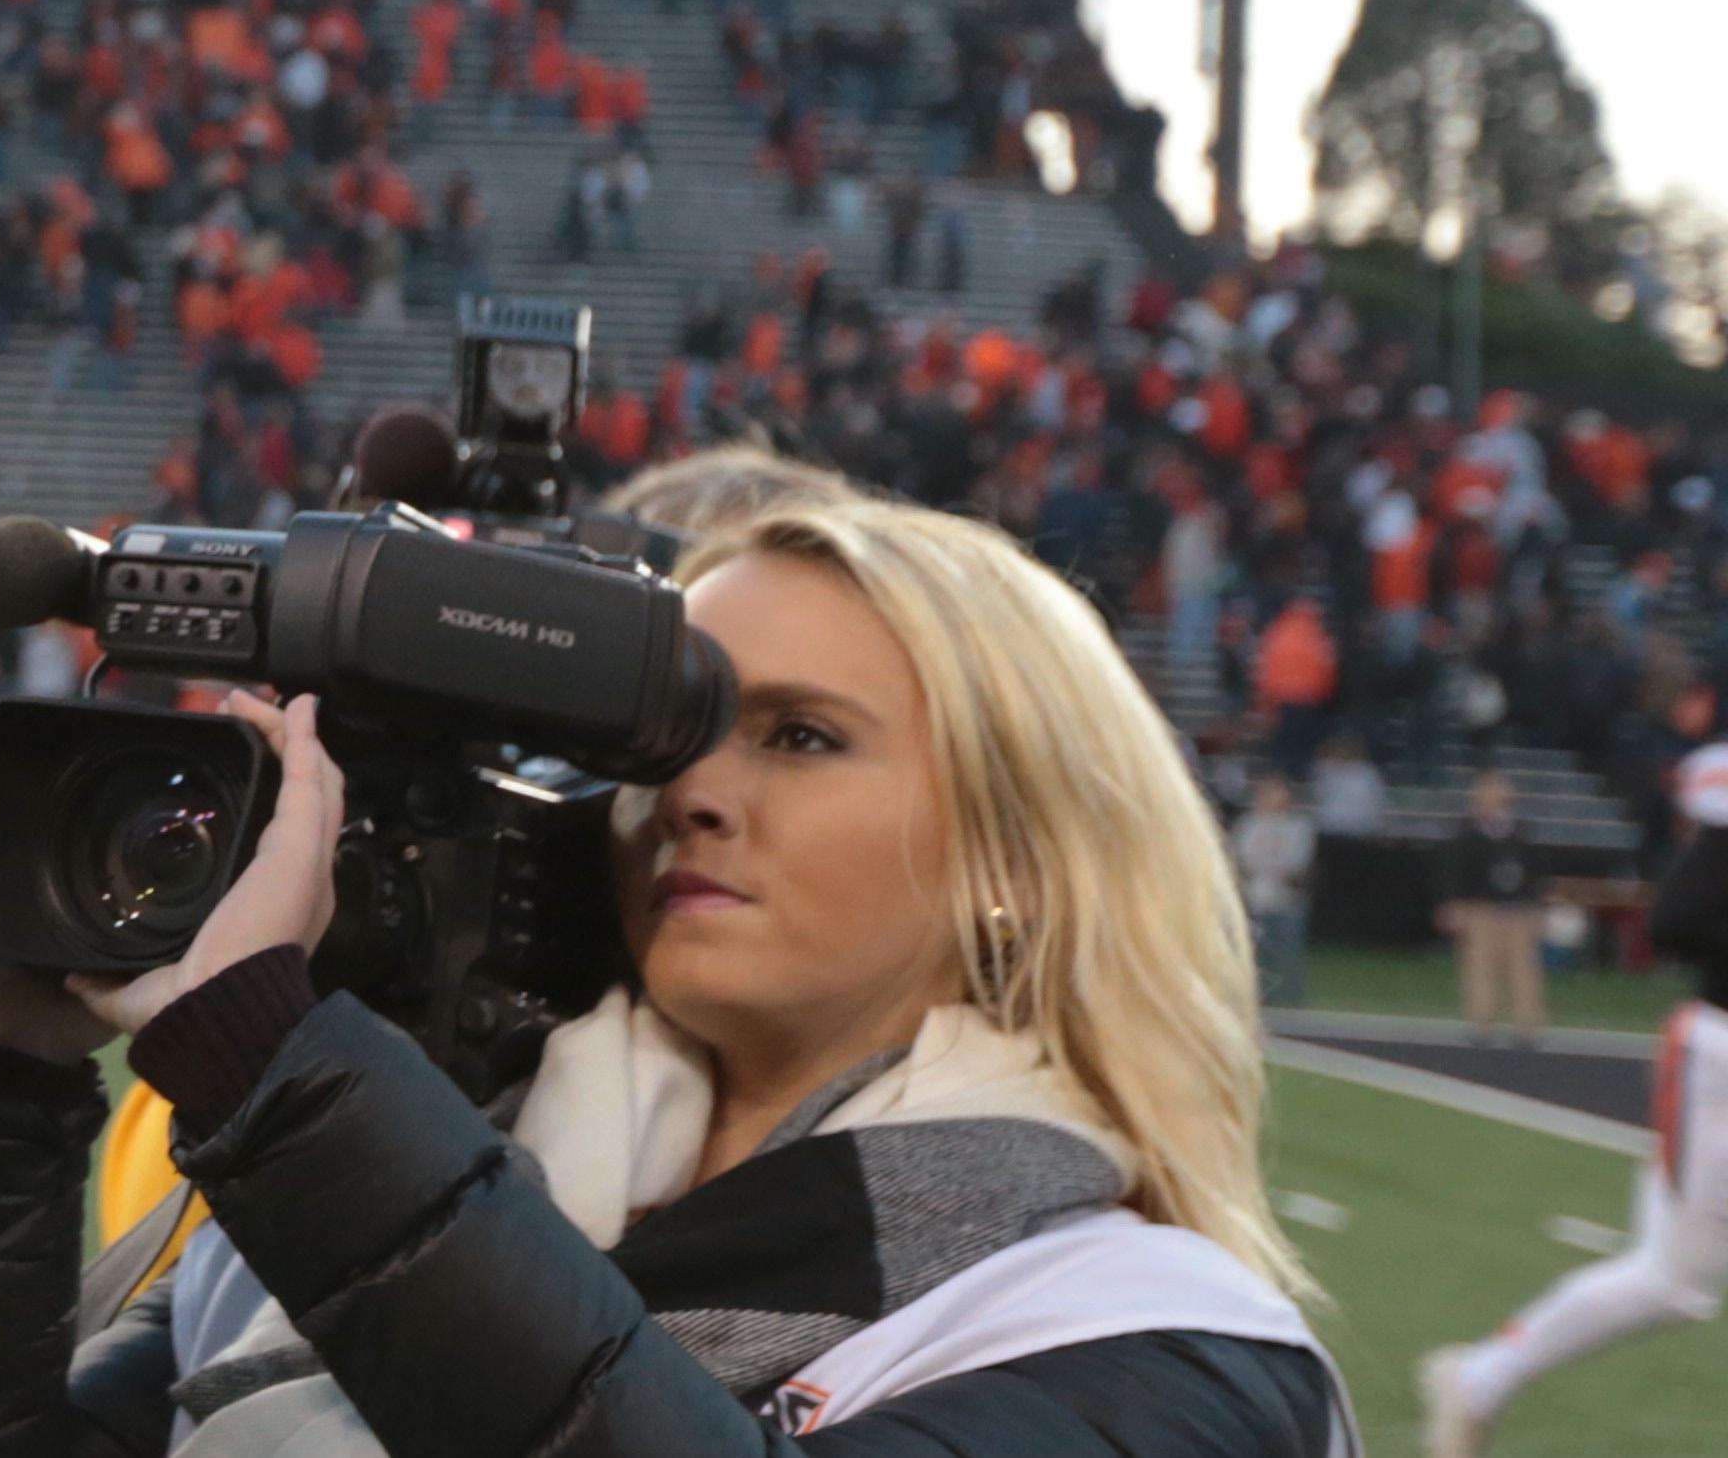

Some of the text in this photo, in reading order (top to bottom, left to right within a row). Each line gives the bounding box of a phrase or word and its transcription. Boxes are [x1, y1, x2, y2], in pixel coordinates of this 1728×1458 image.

[189, 540, 255, 557] SONY
[438, 606, 576, 649] XDCAM HD
